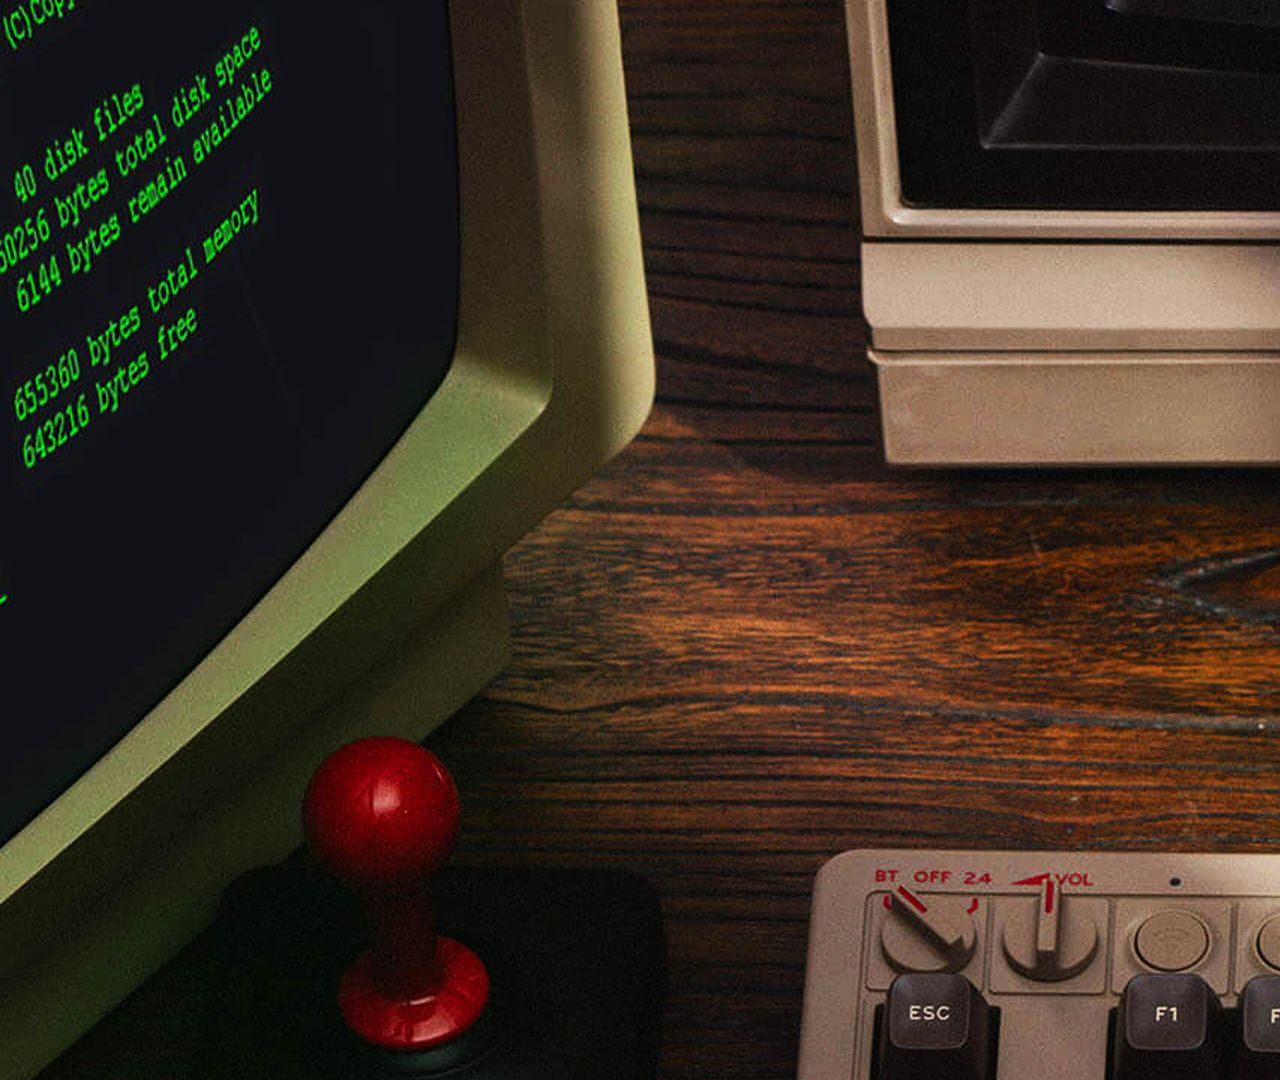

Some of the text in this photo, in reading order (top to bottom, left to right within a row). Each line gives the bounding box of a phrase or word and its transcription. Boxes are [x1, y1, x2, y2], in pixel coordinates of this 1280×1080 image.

[13, 82, 145, 203] 40 disk files
[16, 66, 273, 312] 6144 bytes remain available
[54, 167, 109, 229] bytes
[115, 116, 167, 176] total
[171, 75, 211, 129] disk
[214, 24, 262, 95] space
[14, 187, 261, 422] 655360 bytes total memory
[22, 306, 199, 470] 643216 bytes free
[875, 870, 899, 883] BT
[914, 870, 952, 884] OFF
[1055, 872, 1094, 886] VOL
[909, 1005, 950, 1021] ESC
[1155, 1006, 1177, 1022] F1
